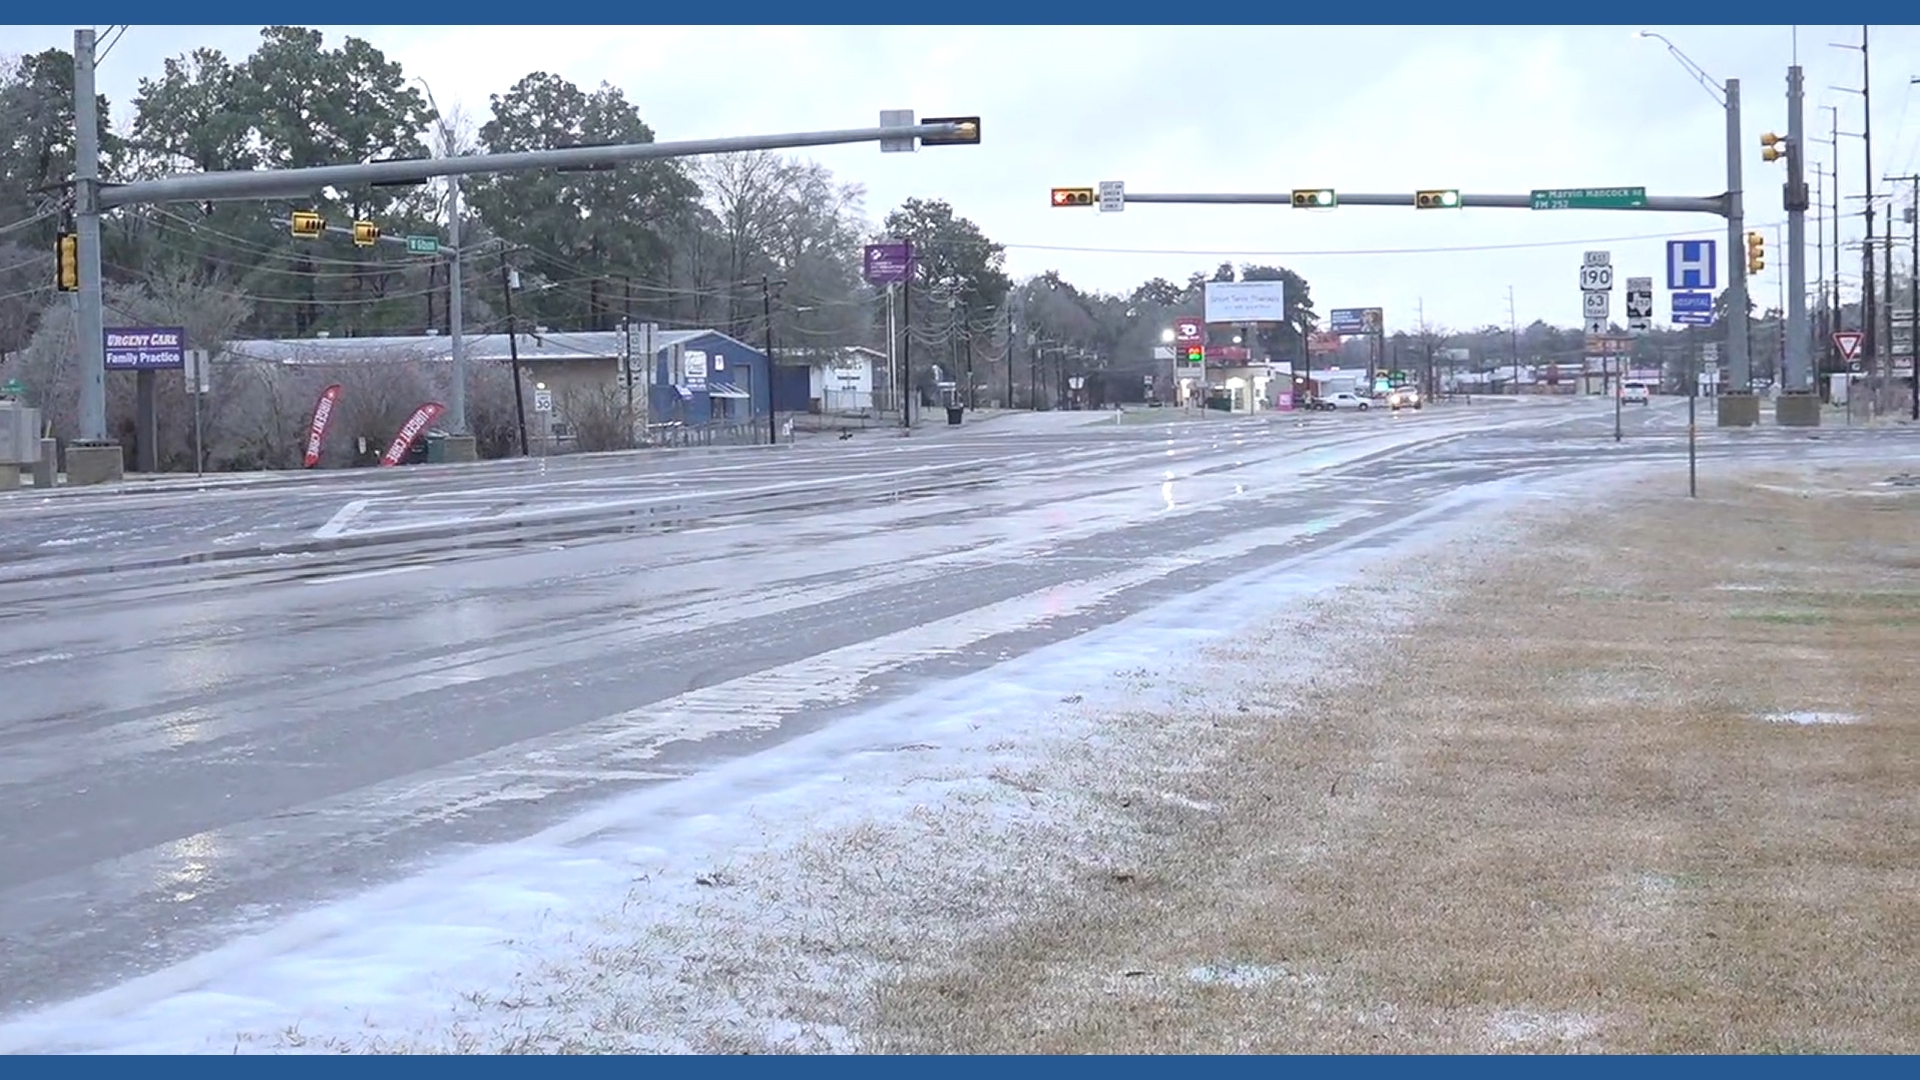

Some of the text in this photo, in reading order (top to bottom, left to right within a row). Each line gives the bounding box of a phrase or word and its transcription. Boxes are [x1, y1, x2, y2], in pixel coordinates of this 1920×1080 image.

[1549, 190, 1584, 198] Marvin
[1586, 189, 1629, 197] Hancock
[1551, 200, 1569, 208] 252
[1587, 251, 1606, 262] EAST
[1673, 243, 1710, 287] H
[1583, 270, 1609, 284] 190
[1587, 295, 1604, 306] 63
[1673, 298, 1709, 307] HOSPITAL
[107, 333, 178, 346] URGENT CARE
[106, 352, 180, 366] Family Practice
[306, 397, 333, 459] URGENT CARE
[385, 409, 430, 463] URGENT CARE
